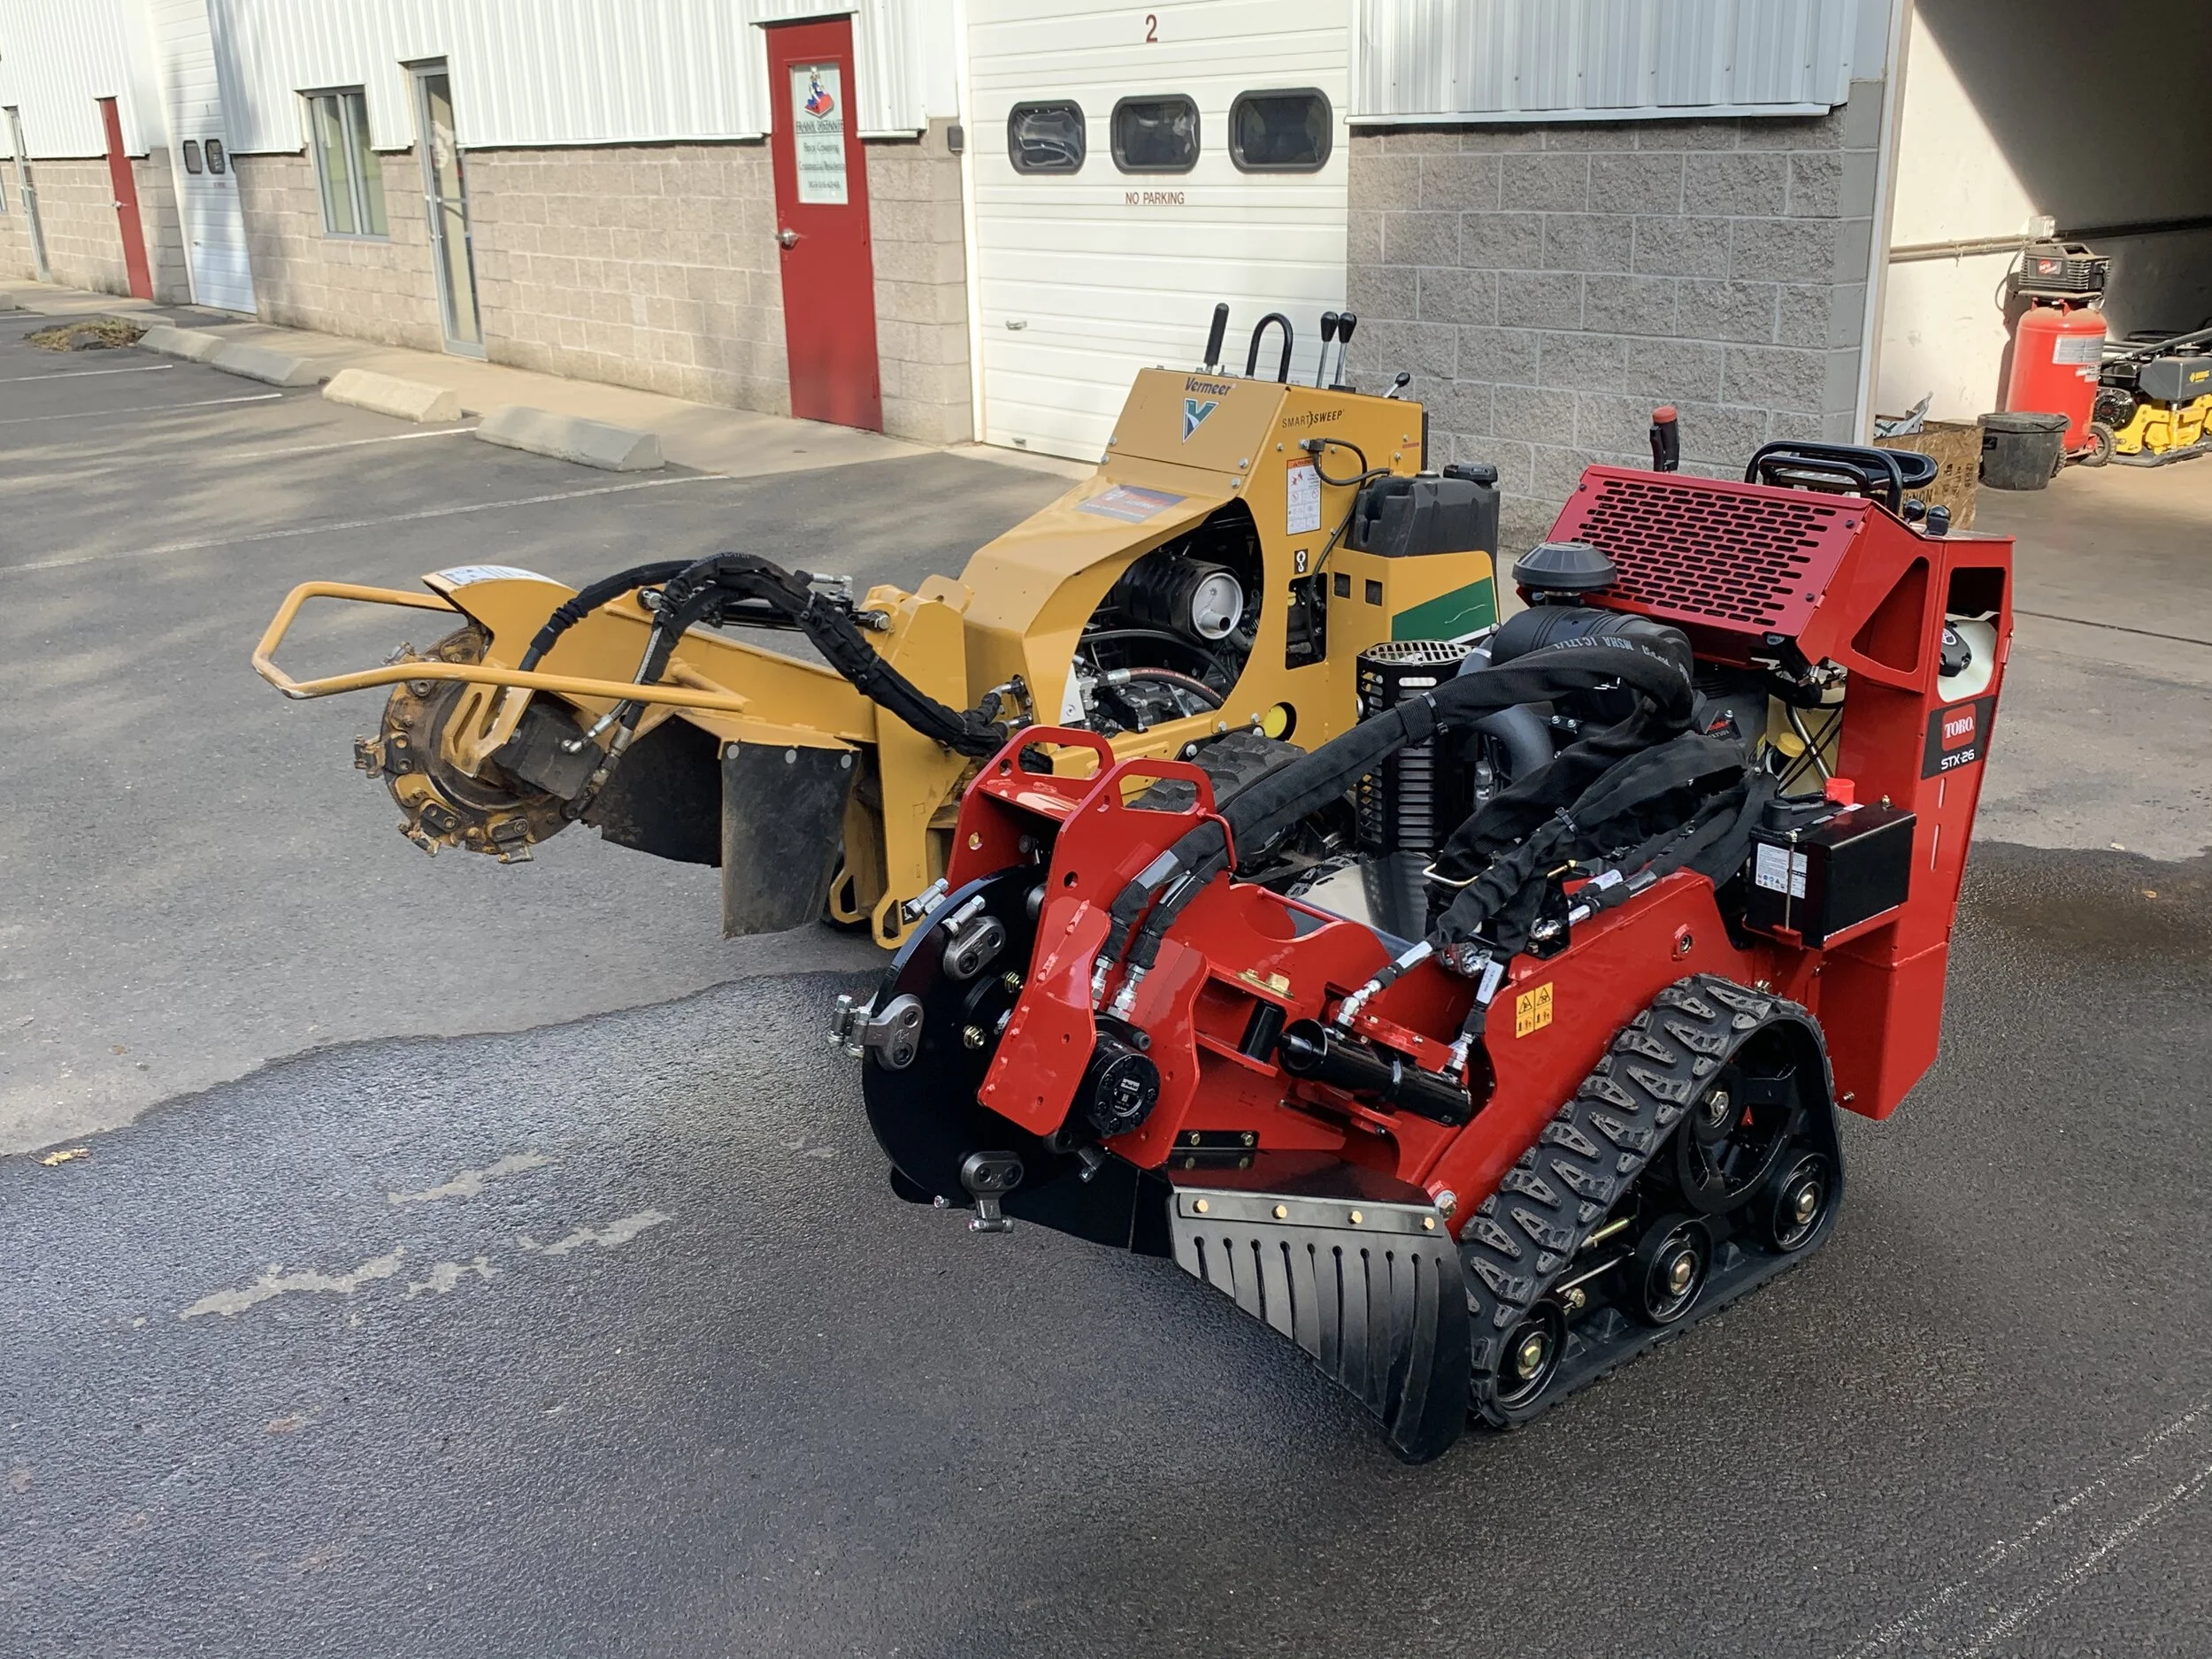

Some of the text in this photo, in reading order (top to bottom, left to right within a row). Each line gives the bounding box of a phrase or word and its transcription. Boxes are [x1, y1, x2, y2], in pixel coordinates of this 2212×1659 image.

[1145, 14, 1158, 43] 2
[1125, 191, 1185, 204] NO PARKING
[1185, 376, 1231, 396] Vermeer
[1601, 636, 1635, 651] MSHA
[1944, 716, 1974, 740] TORO
